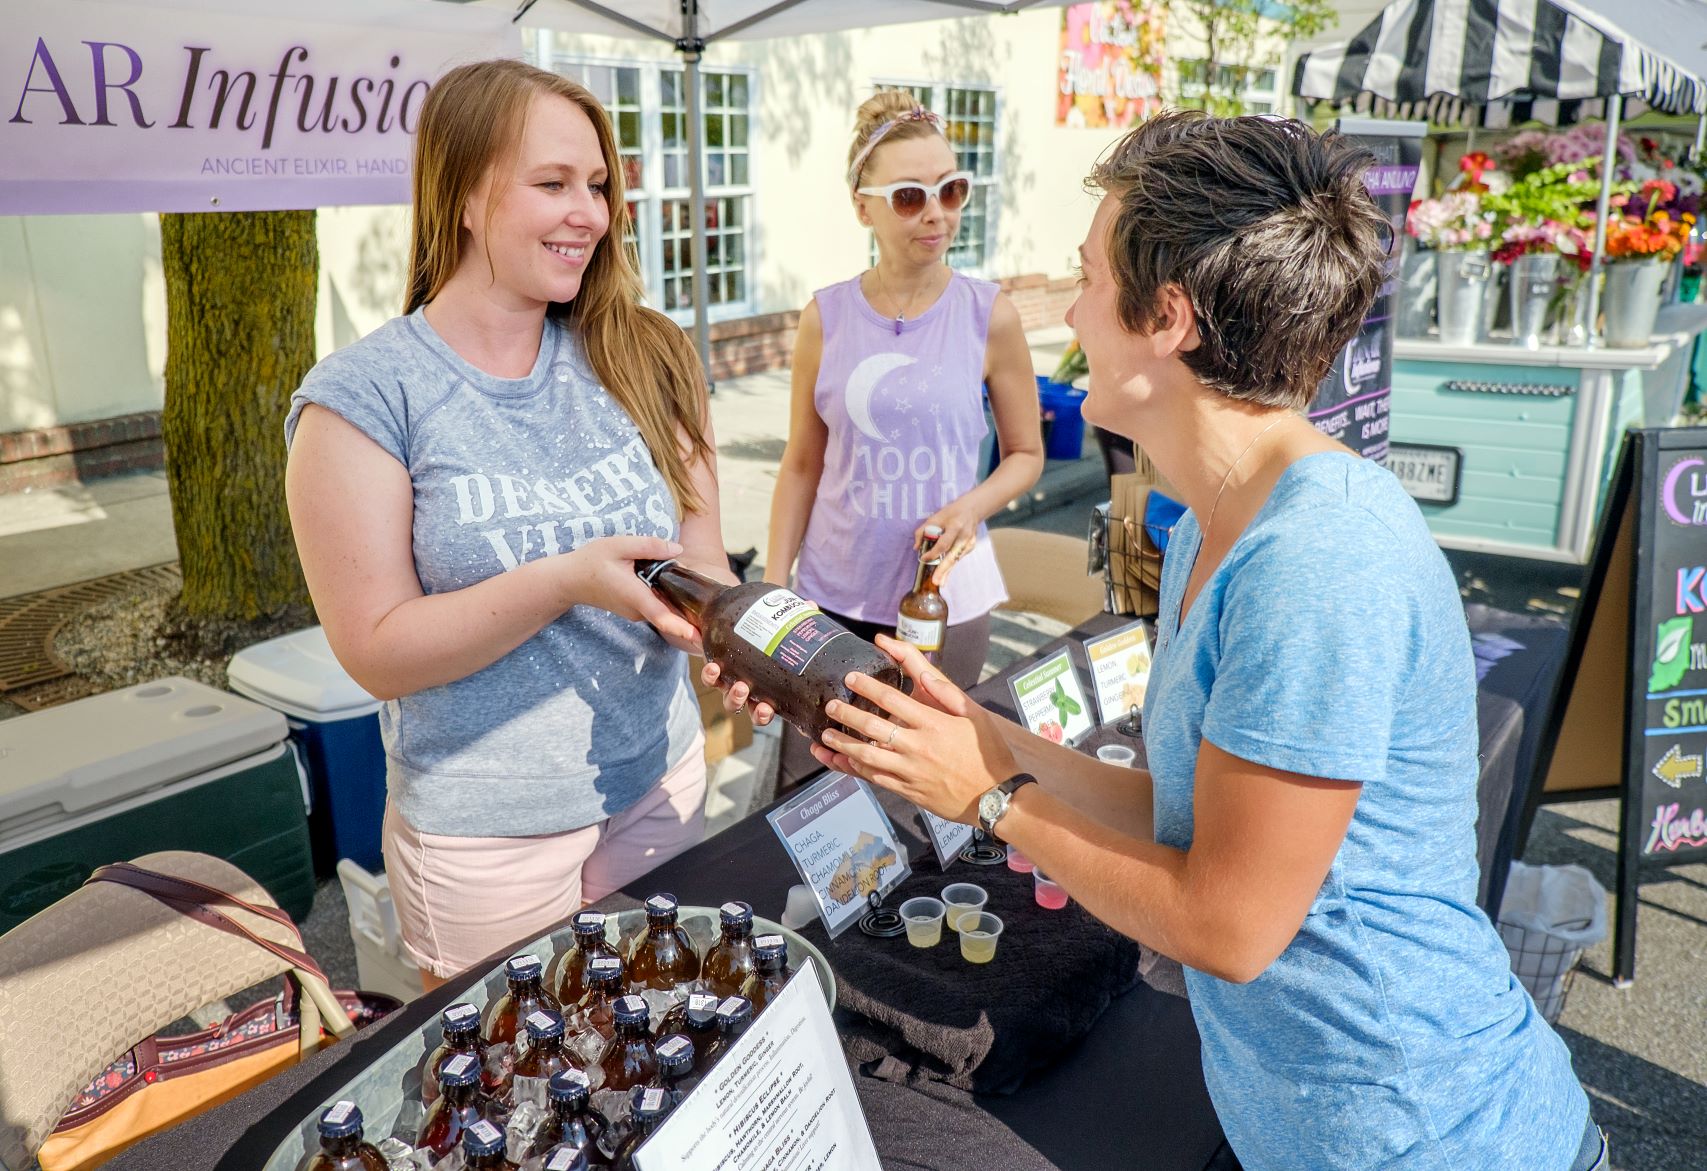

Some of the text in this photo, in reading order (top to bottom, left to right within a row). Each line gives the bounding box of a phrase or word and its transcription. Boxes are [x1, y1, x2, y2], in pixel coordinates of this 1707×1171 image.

[8, 36, 156, 129] AR
[200, 157, 288, 176] ANCIENT
[294, 158, 351, 176] ELIXIR.
[449, 437, 660, 527] DESERT
[800, 789, 840, 820] Chaga Bliss
[719, 1036, 767, 1091] GOLDEN GODDESS
[733, 1076, 781, 1136] HIBISCUS ECLIPSE
[761, 1076, 793, 1116] MARSHMALLOW
[765, 1103, 781, 1124] LEMON
[780, 1088, 793, 1106] BALM
[775, 1134, 791, 1156] BLISS
[823, 1142, 838, 1162] LEMON
